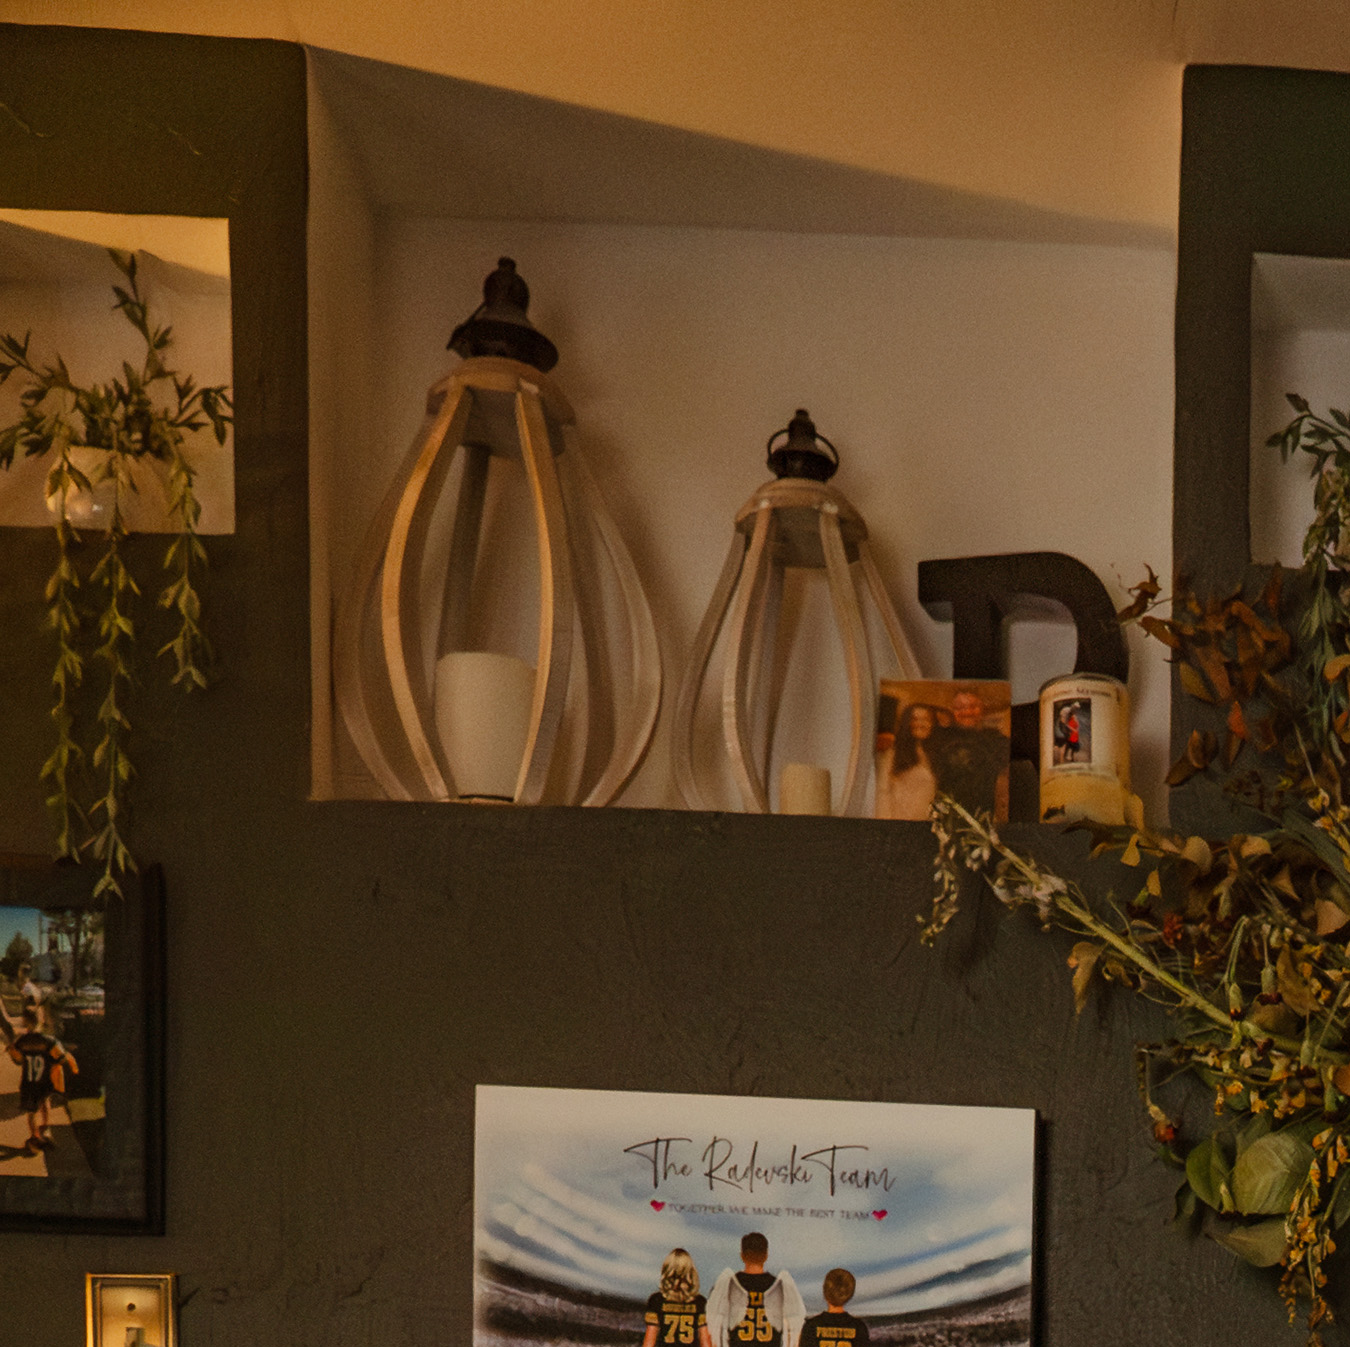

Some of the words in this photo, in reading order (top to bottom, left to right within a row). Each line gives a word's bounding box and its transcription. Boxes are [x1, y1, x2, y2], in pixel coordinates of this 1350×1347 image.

[623, 1137, 693, 1189] The
[801, 1144, 897, 1197] Team
[785, 1207, 806, 1218] THE
[810, 1208, 835, 1219] BEST
[664, 1314, 694, 1344] 75
